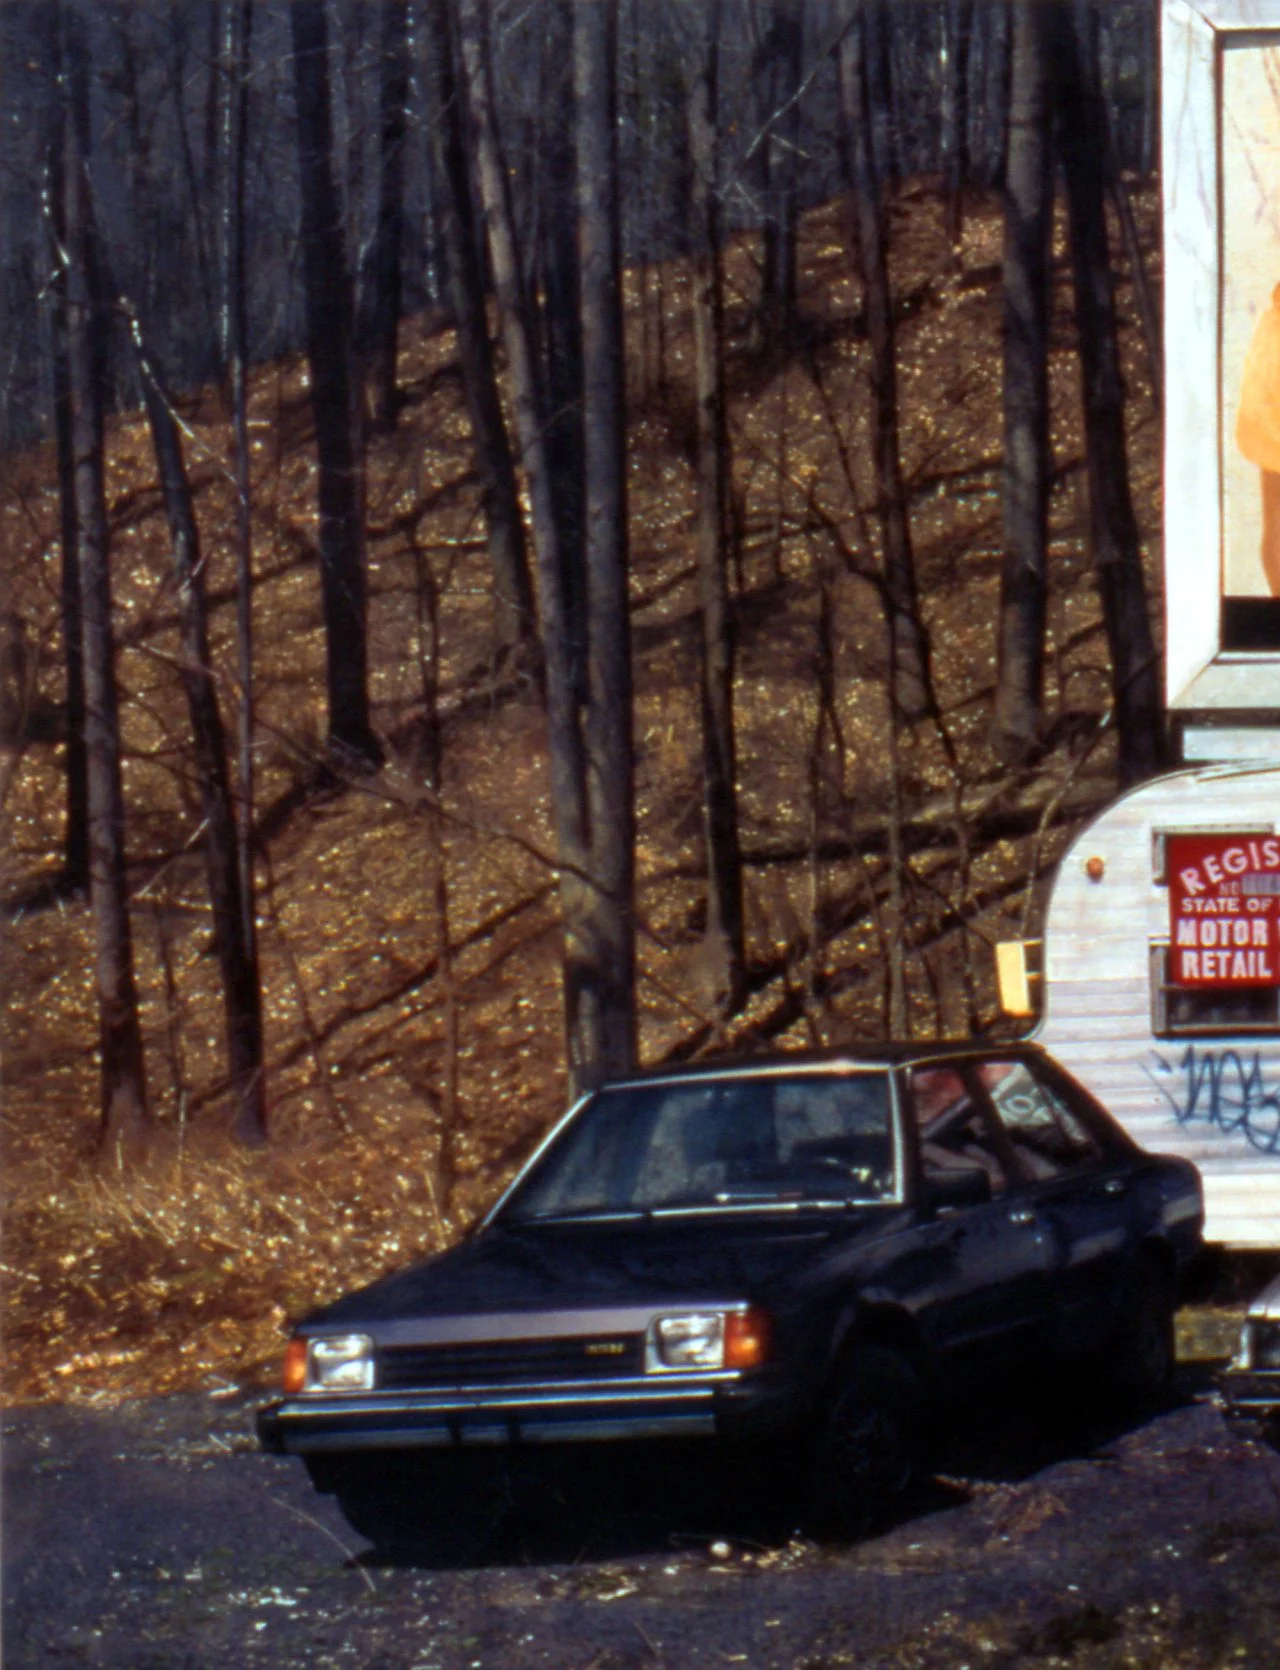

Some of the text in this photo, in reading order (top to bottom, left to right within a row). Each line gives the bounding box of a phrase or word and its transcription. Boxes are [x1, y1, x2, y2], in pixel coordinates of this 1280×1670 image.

[1181, 897, 1240, 913] STATE
[1246, 898, 1272, 912] OF
[1176, 917, 1269, 946] MOTOR
[1181, 949, 1273, 979] RETAIL
